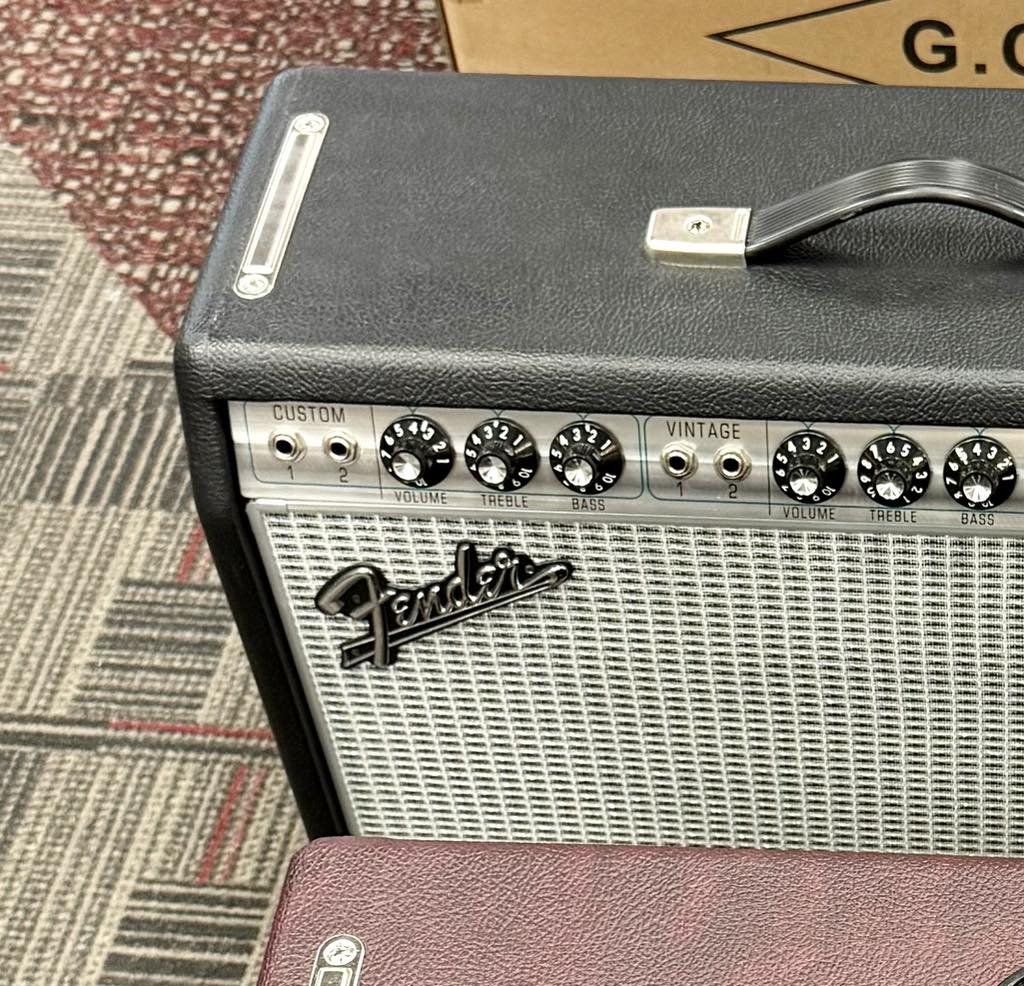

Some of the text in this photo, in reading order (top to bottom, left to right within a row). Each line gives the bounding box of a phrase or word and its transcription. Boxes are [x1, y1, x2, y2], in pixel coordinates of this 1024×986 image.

[273, 404, 345, 423] CUSTOM
[666, 421, 741, 439] VINTAGE
[287, 465, 295, 480] 1
[339, 467, 349, 483] 2
[677, 482, 684, 496] 1
[729, 484, 738, 499] 2
[395, 491, 448, 505] VOLUME
[481, 494, 529, 508] TREBLE
[572, 498, 605, 511] BASS
[783, 507, 836, 520] VOLUME
[870, 510, 917, 523] TREBLE
[961, 513, 995, 526] BASS
[314, 540, 573, 669] Fender
